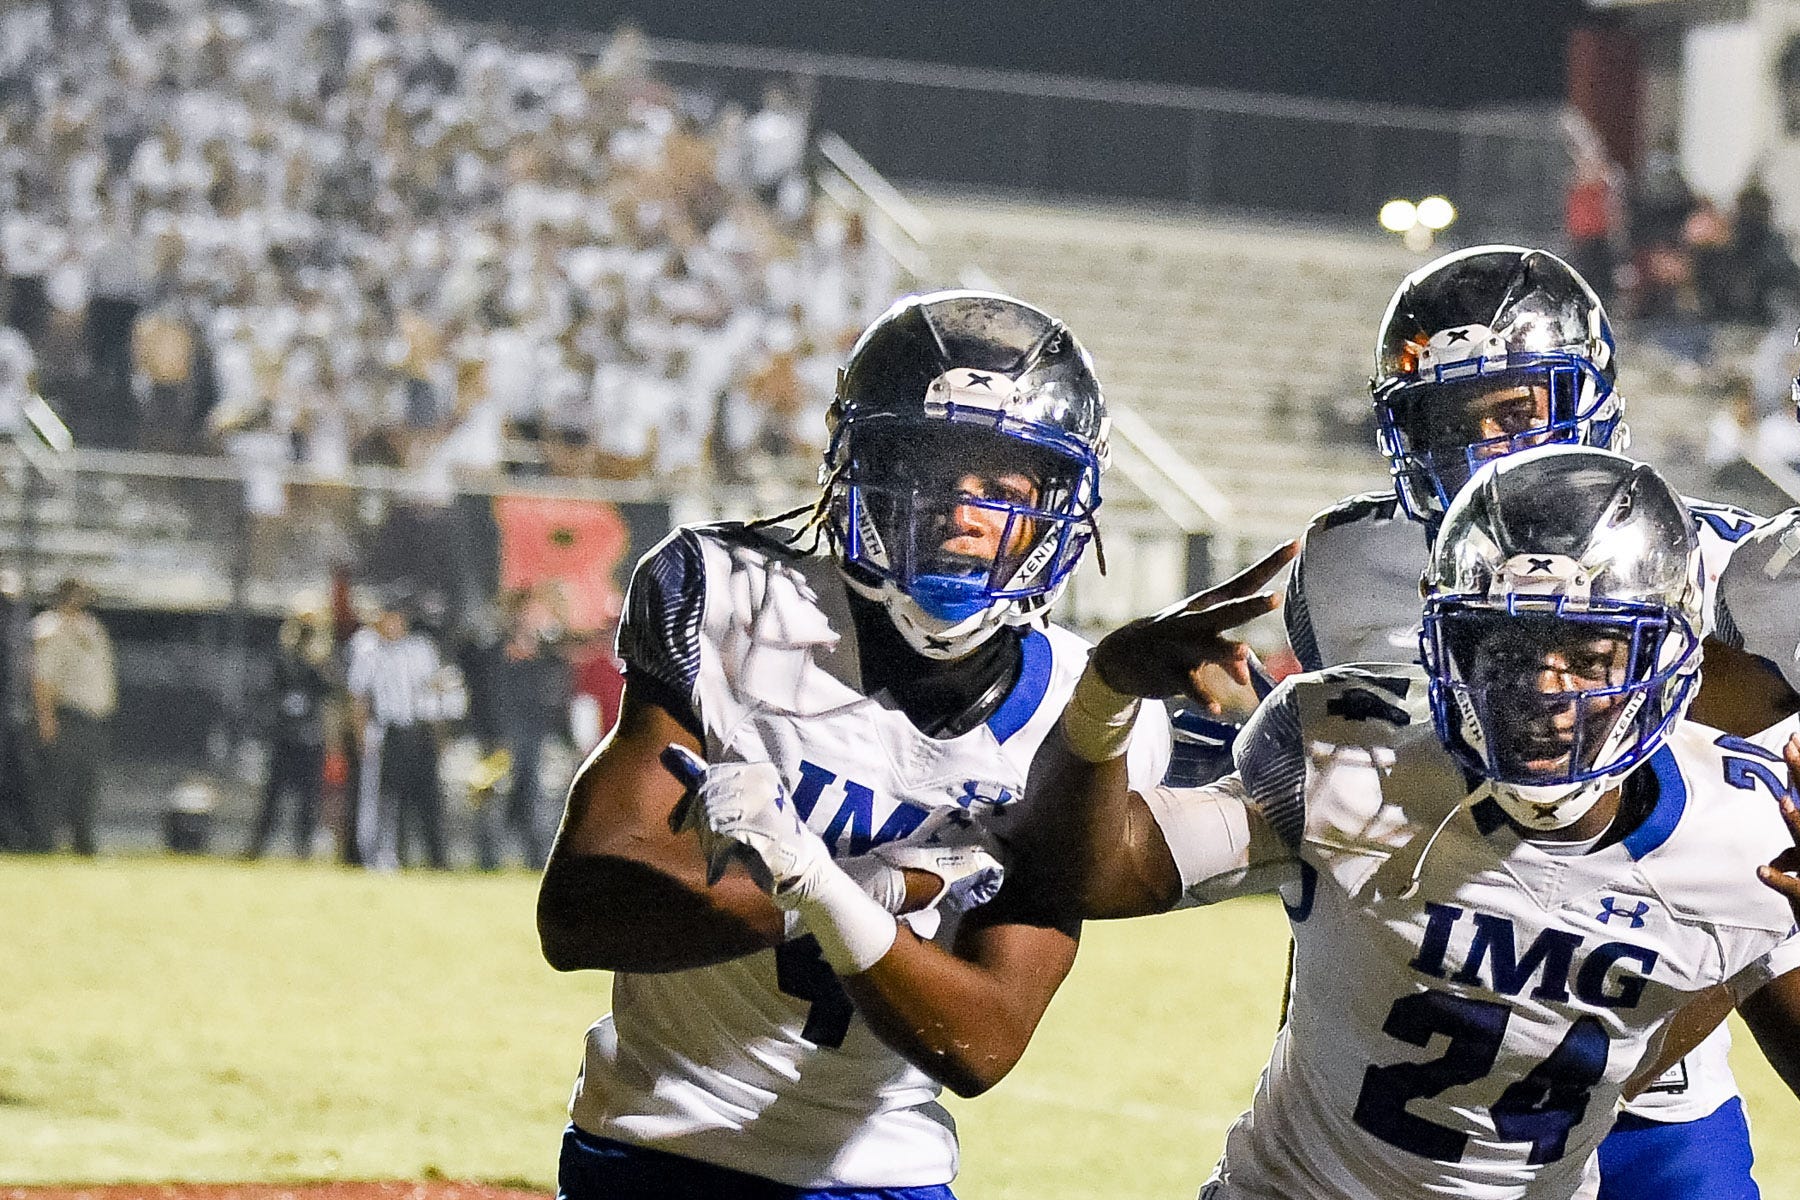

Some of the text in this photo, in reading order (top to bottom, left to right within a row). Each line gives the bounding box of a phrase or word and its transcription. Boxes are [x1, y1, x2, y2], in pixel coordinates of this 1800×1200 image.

[1610, 686, 1647, 742] XENIT
[791, 759, 930, 857] IM
[1409, 902, 1658, 1010] IMG
[1353, 987, 1611, 1167] 24
